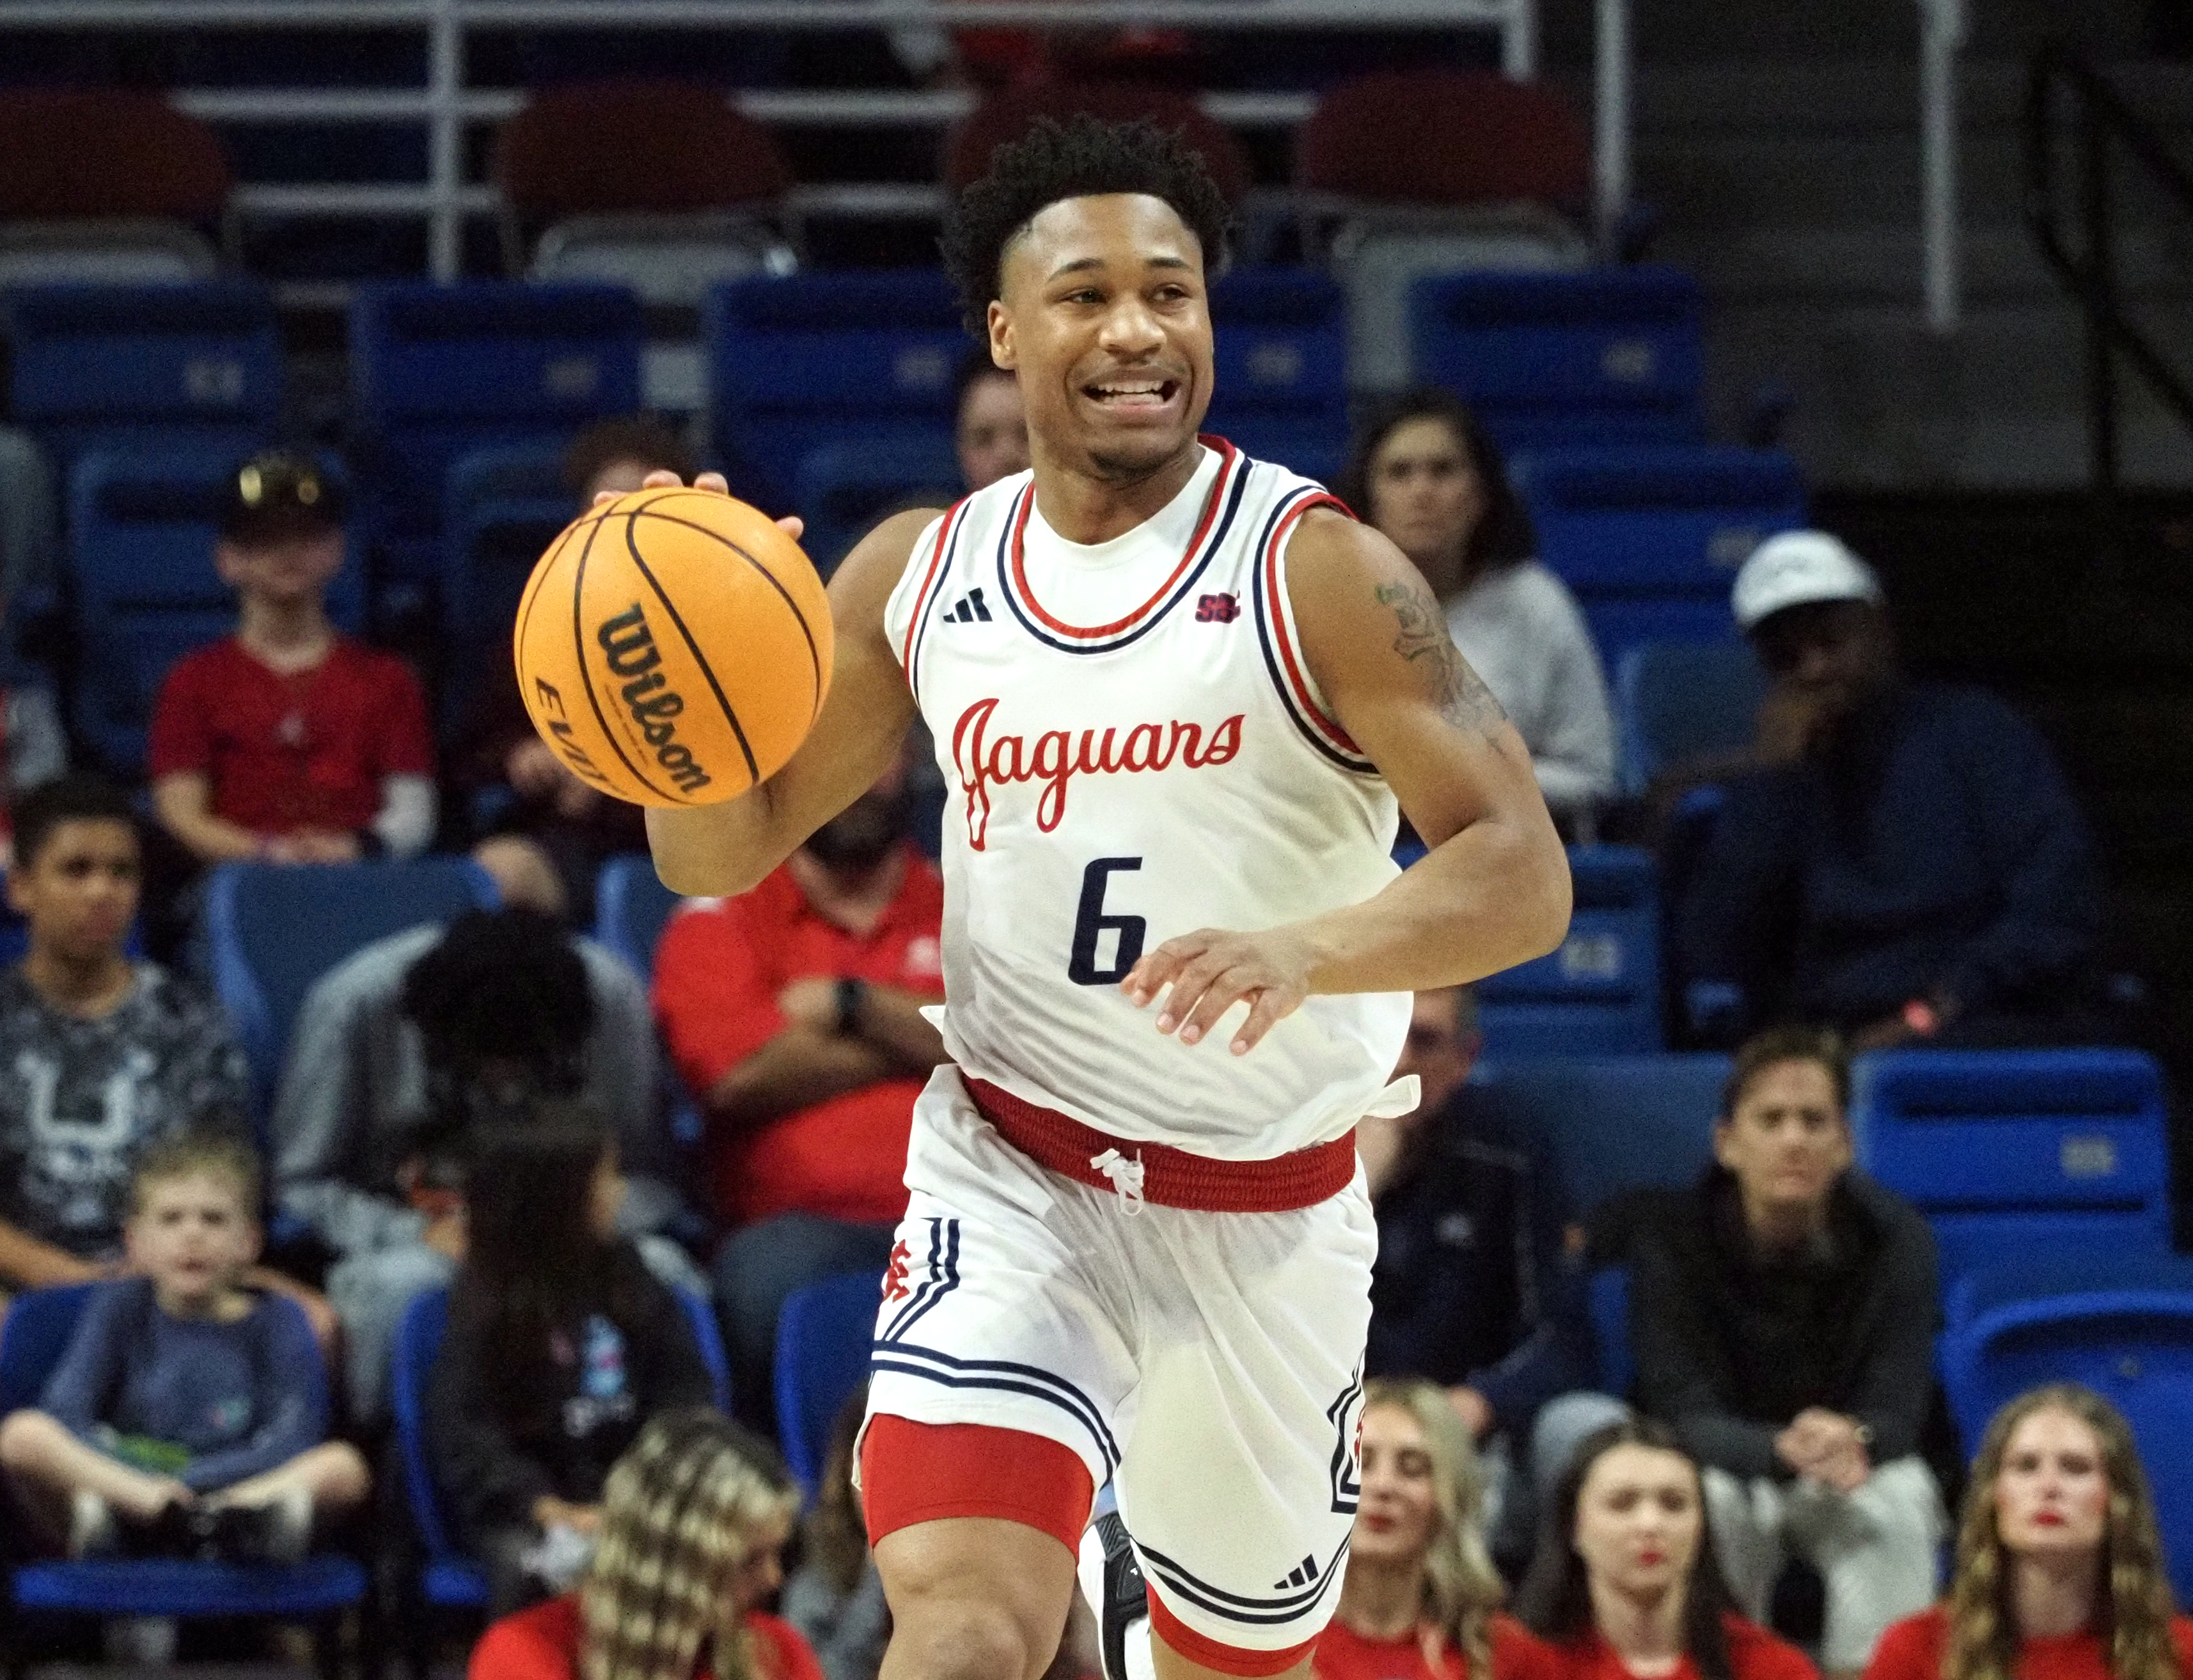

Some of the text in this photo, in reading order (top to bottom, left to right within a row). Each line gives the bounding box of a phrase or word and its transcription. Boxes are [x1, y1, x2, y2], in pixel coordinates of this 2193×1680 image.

[597, 602, 711, 793] Wilson
[952, 698, 1246, 852] Jaguars
[1067, 856, 1147, 986] 6
